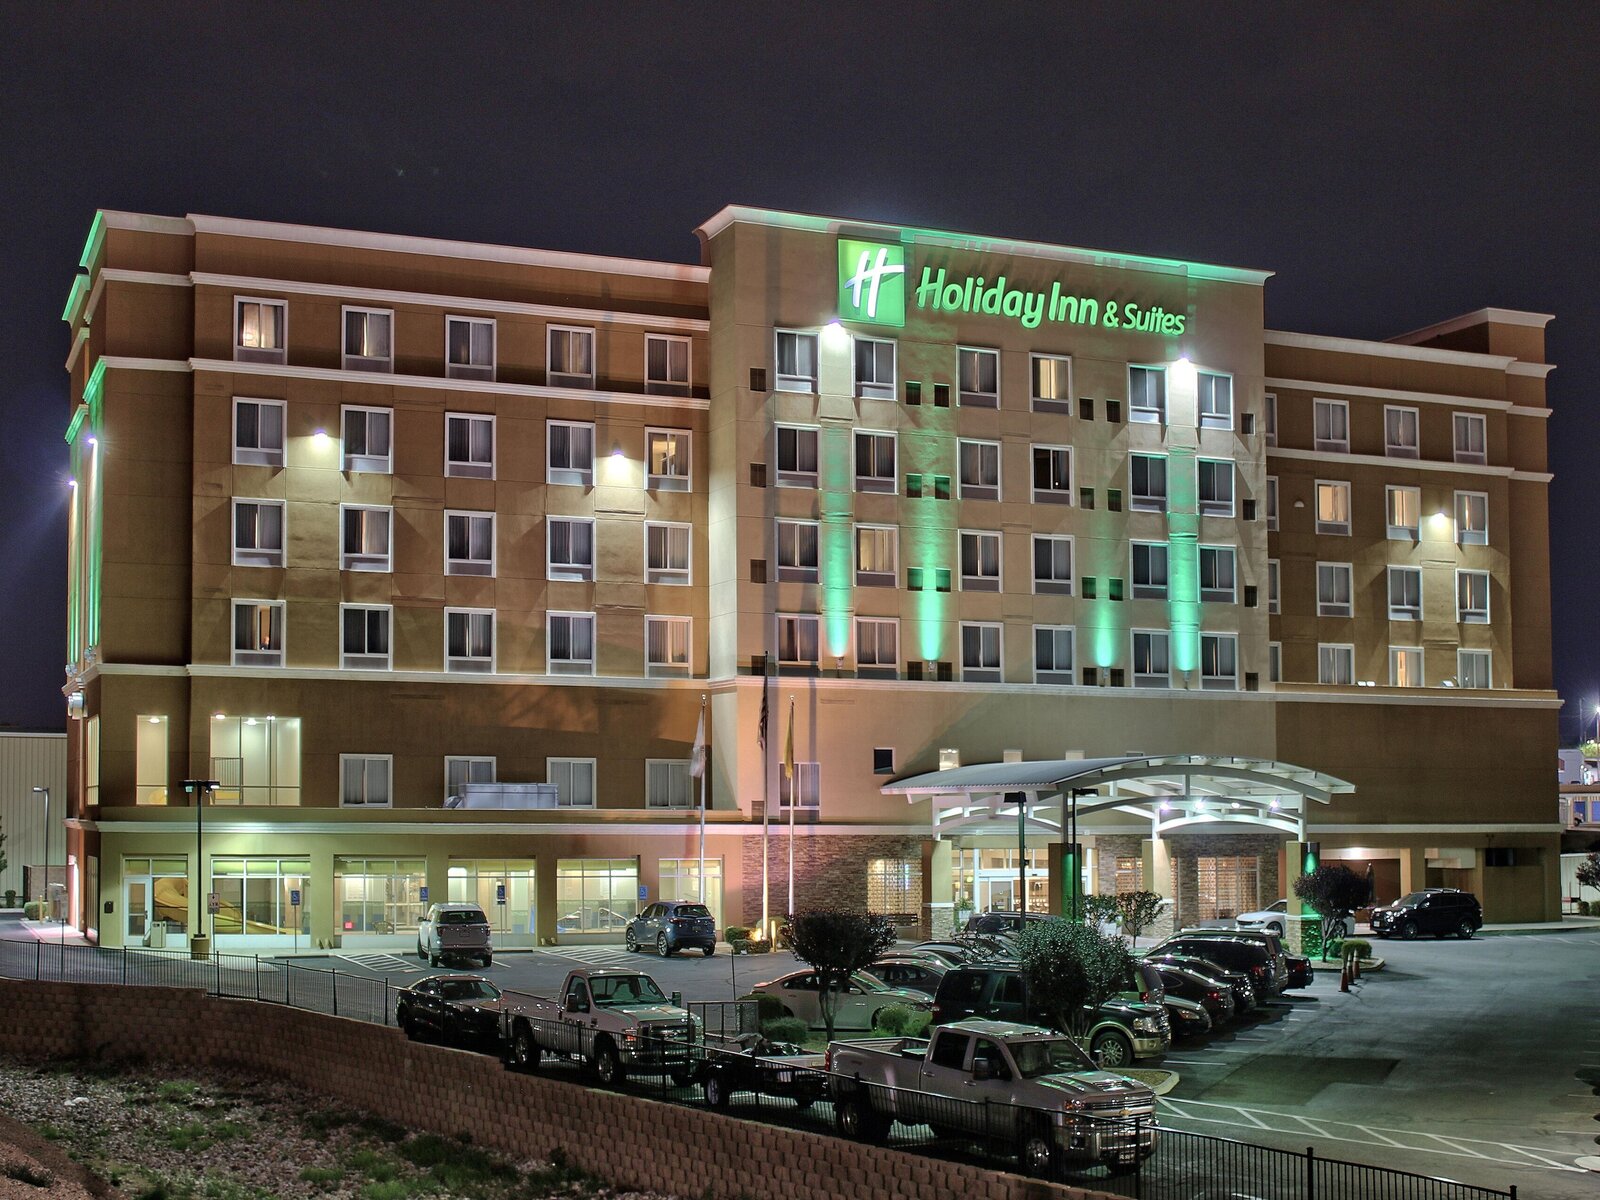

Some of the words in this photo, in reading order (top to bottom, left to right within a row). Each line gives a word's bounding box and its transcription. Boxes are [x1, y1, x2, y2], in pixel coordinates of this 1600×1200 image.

[915, 266, 1045, 329] Holiday
[1048, 281, 1098, 326] Inn
[1102, 300, 1119, 328] &
[1122, 303, 1186, 336] Suites
